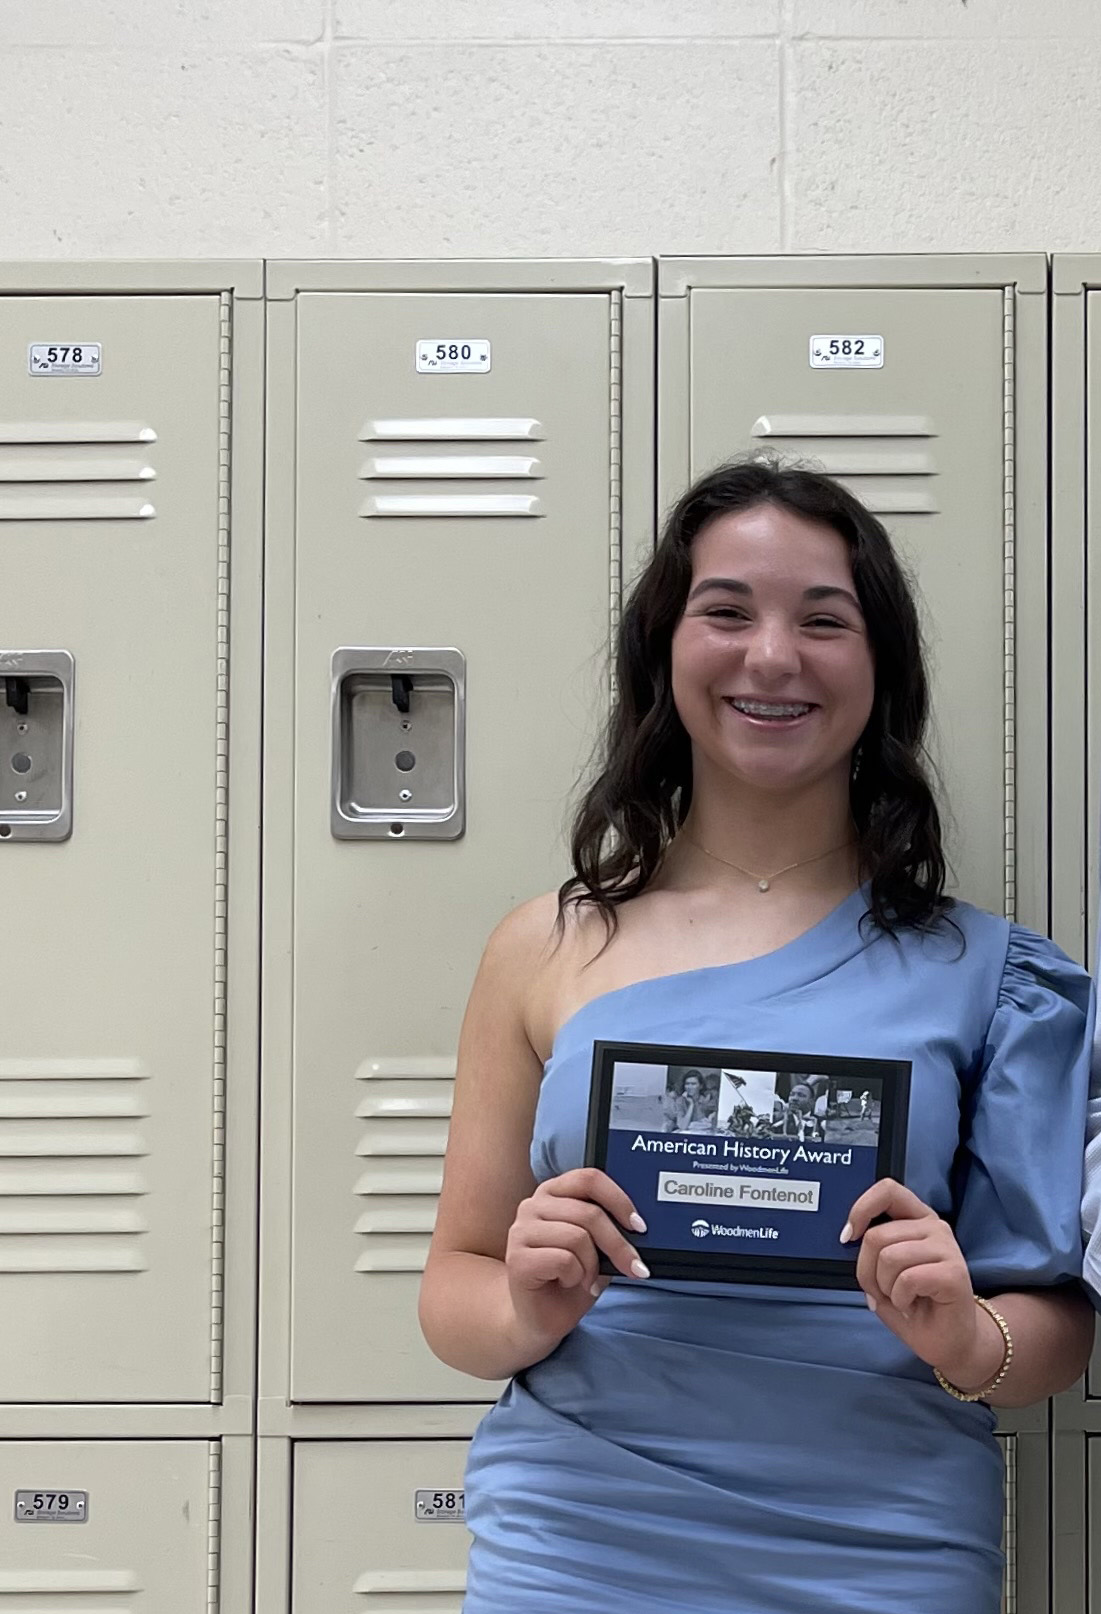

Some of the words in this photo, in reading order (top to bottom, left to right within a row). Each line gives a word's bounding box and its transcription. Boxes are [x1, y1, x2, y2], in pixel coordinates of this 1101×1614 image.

[47, 347, 82, 363] 578
[436, 344, 471, 360] 580
[829, 340, 865, 355] 582
[631, 1134, 717, 1156] American
[723, 1140, 790, 1165] History
[793, 1145, 852, 1165] Award
[729, 1162, 739, 1172] by
[664, 1180, 734, 1199] Caroline
[739, 1185, 814, 1204] Fontenot
[711, 1224, 779, 1239] WoodmenLife
[33, 1494, 69, 1510] 579
[432, 1493, 464, 1509] 581
